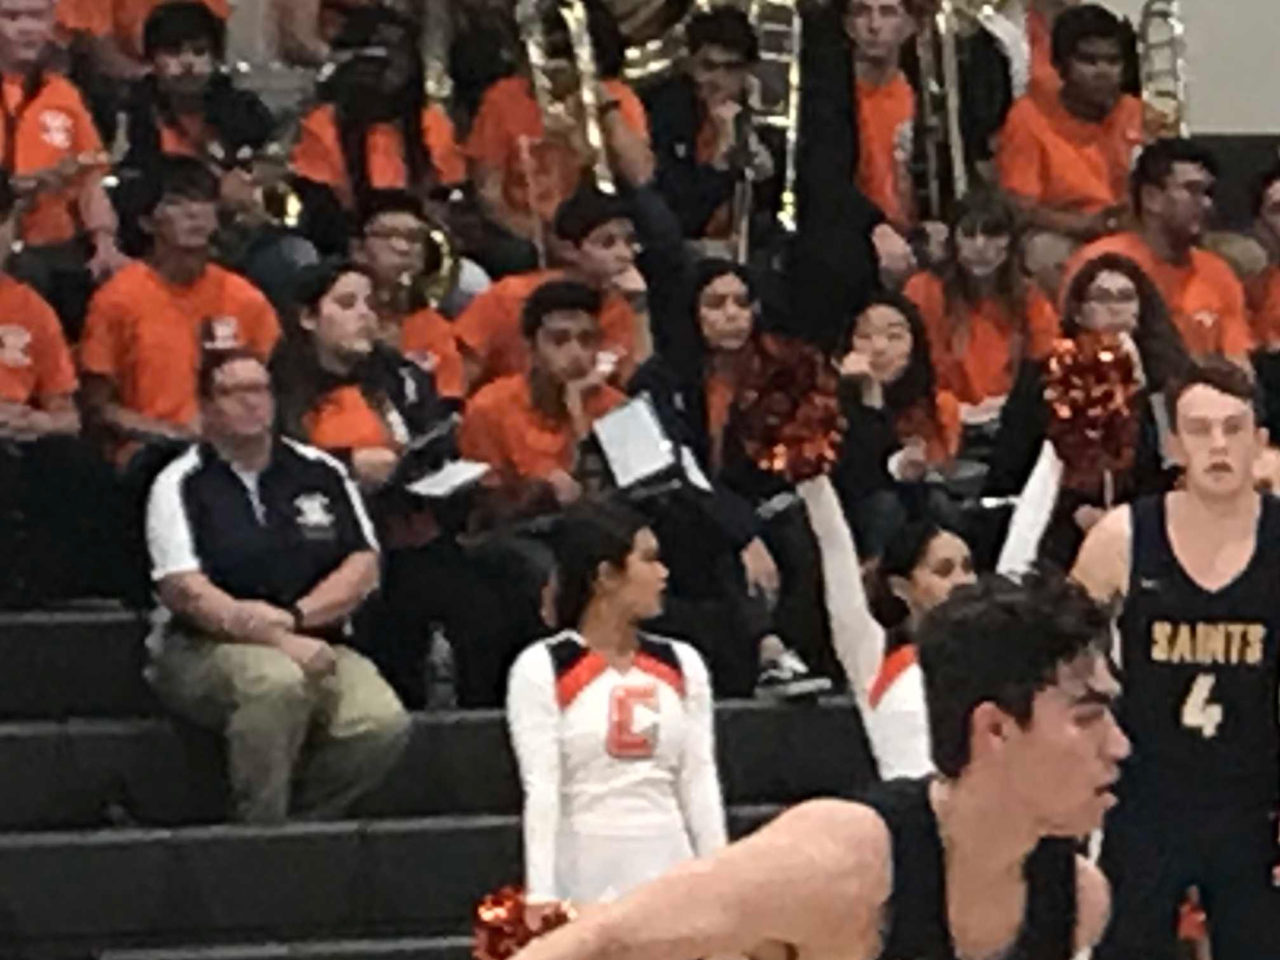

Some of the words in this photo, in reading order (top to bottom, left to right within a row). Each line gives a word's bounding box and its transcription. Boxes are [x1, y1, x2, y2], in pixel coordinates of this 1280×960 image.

[1152, 621, 1267, 665] SAINTS
[606, 684, 660, 760] C
[1181, 673, 1223, 738] 4
